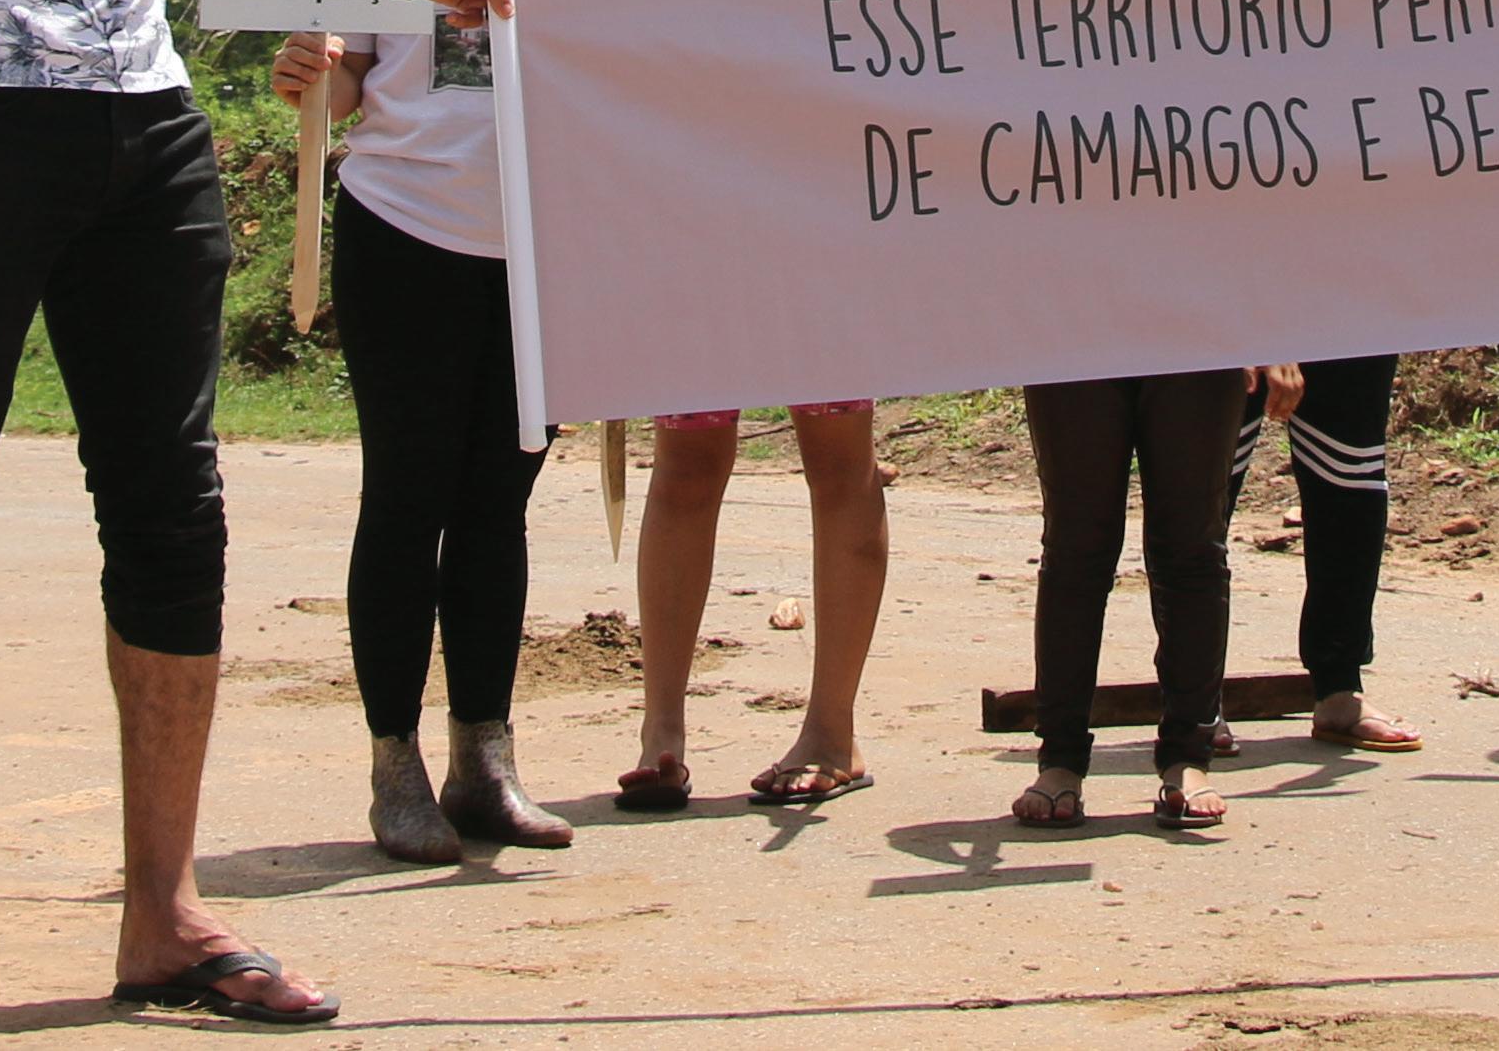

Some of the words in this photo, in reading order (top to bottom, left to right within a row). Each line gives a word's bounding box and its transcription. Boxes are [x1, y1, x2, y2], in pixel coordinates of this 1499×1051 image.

[865, 124, 939, 221] DE
[981, 97, 1318, 206] CAMARGOS
[1352, 97, 1388, 181] E
